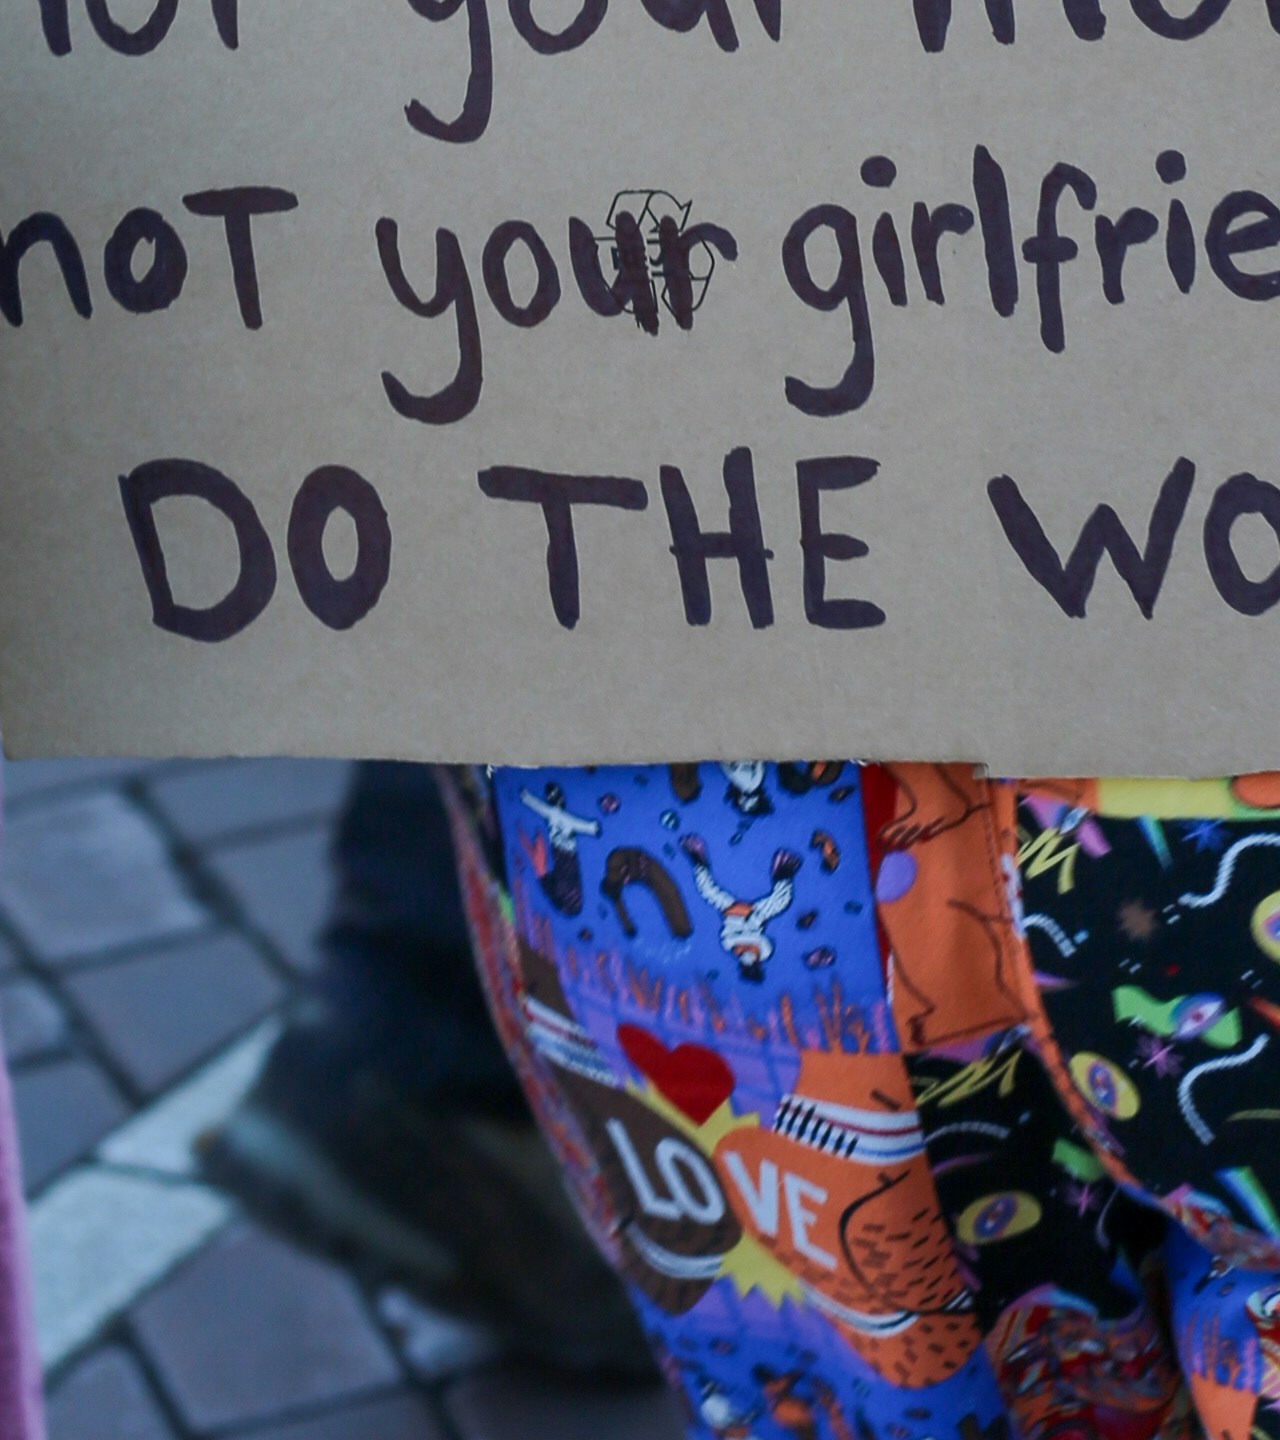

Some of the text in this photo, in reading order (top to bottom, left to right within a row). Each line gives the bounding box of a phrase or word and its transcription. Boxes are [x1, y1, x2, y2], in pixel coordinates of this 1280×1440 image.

[375, 210, 739, 426] your
[118, 458, 392, 643] DO
[478, 447, 886, 631] THE
[607, 1118, 838, 1272] LOVE
